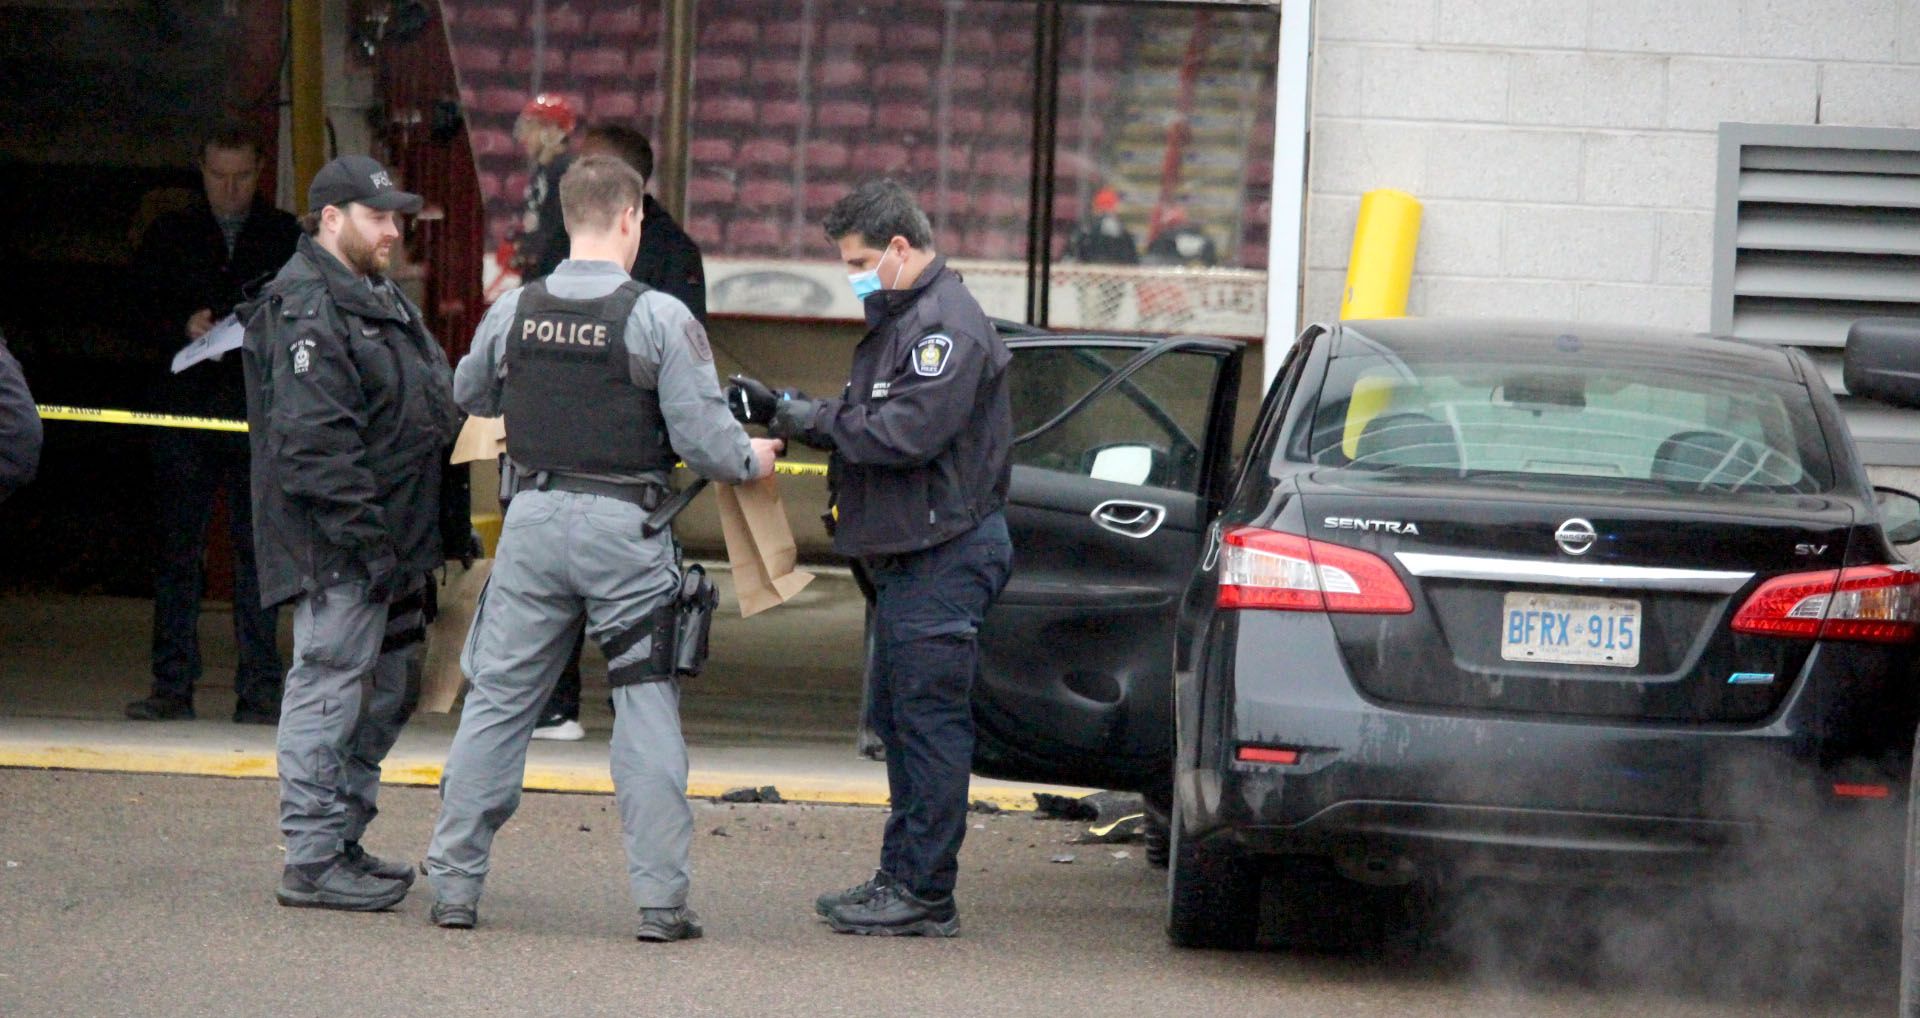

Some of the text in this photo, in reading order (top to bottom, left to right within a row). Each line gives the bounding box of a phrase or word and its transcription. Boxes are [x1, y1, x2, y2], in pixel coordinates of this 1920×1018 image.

[522, 319, 607, 346] POLICE
[1323, 516, 1420, 536] SENTRA
[1794, 543, 1829, 555] SV
[1508, 610, 1634, 650] BFRX 915
